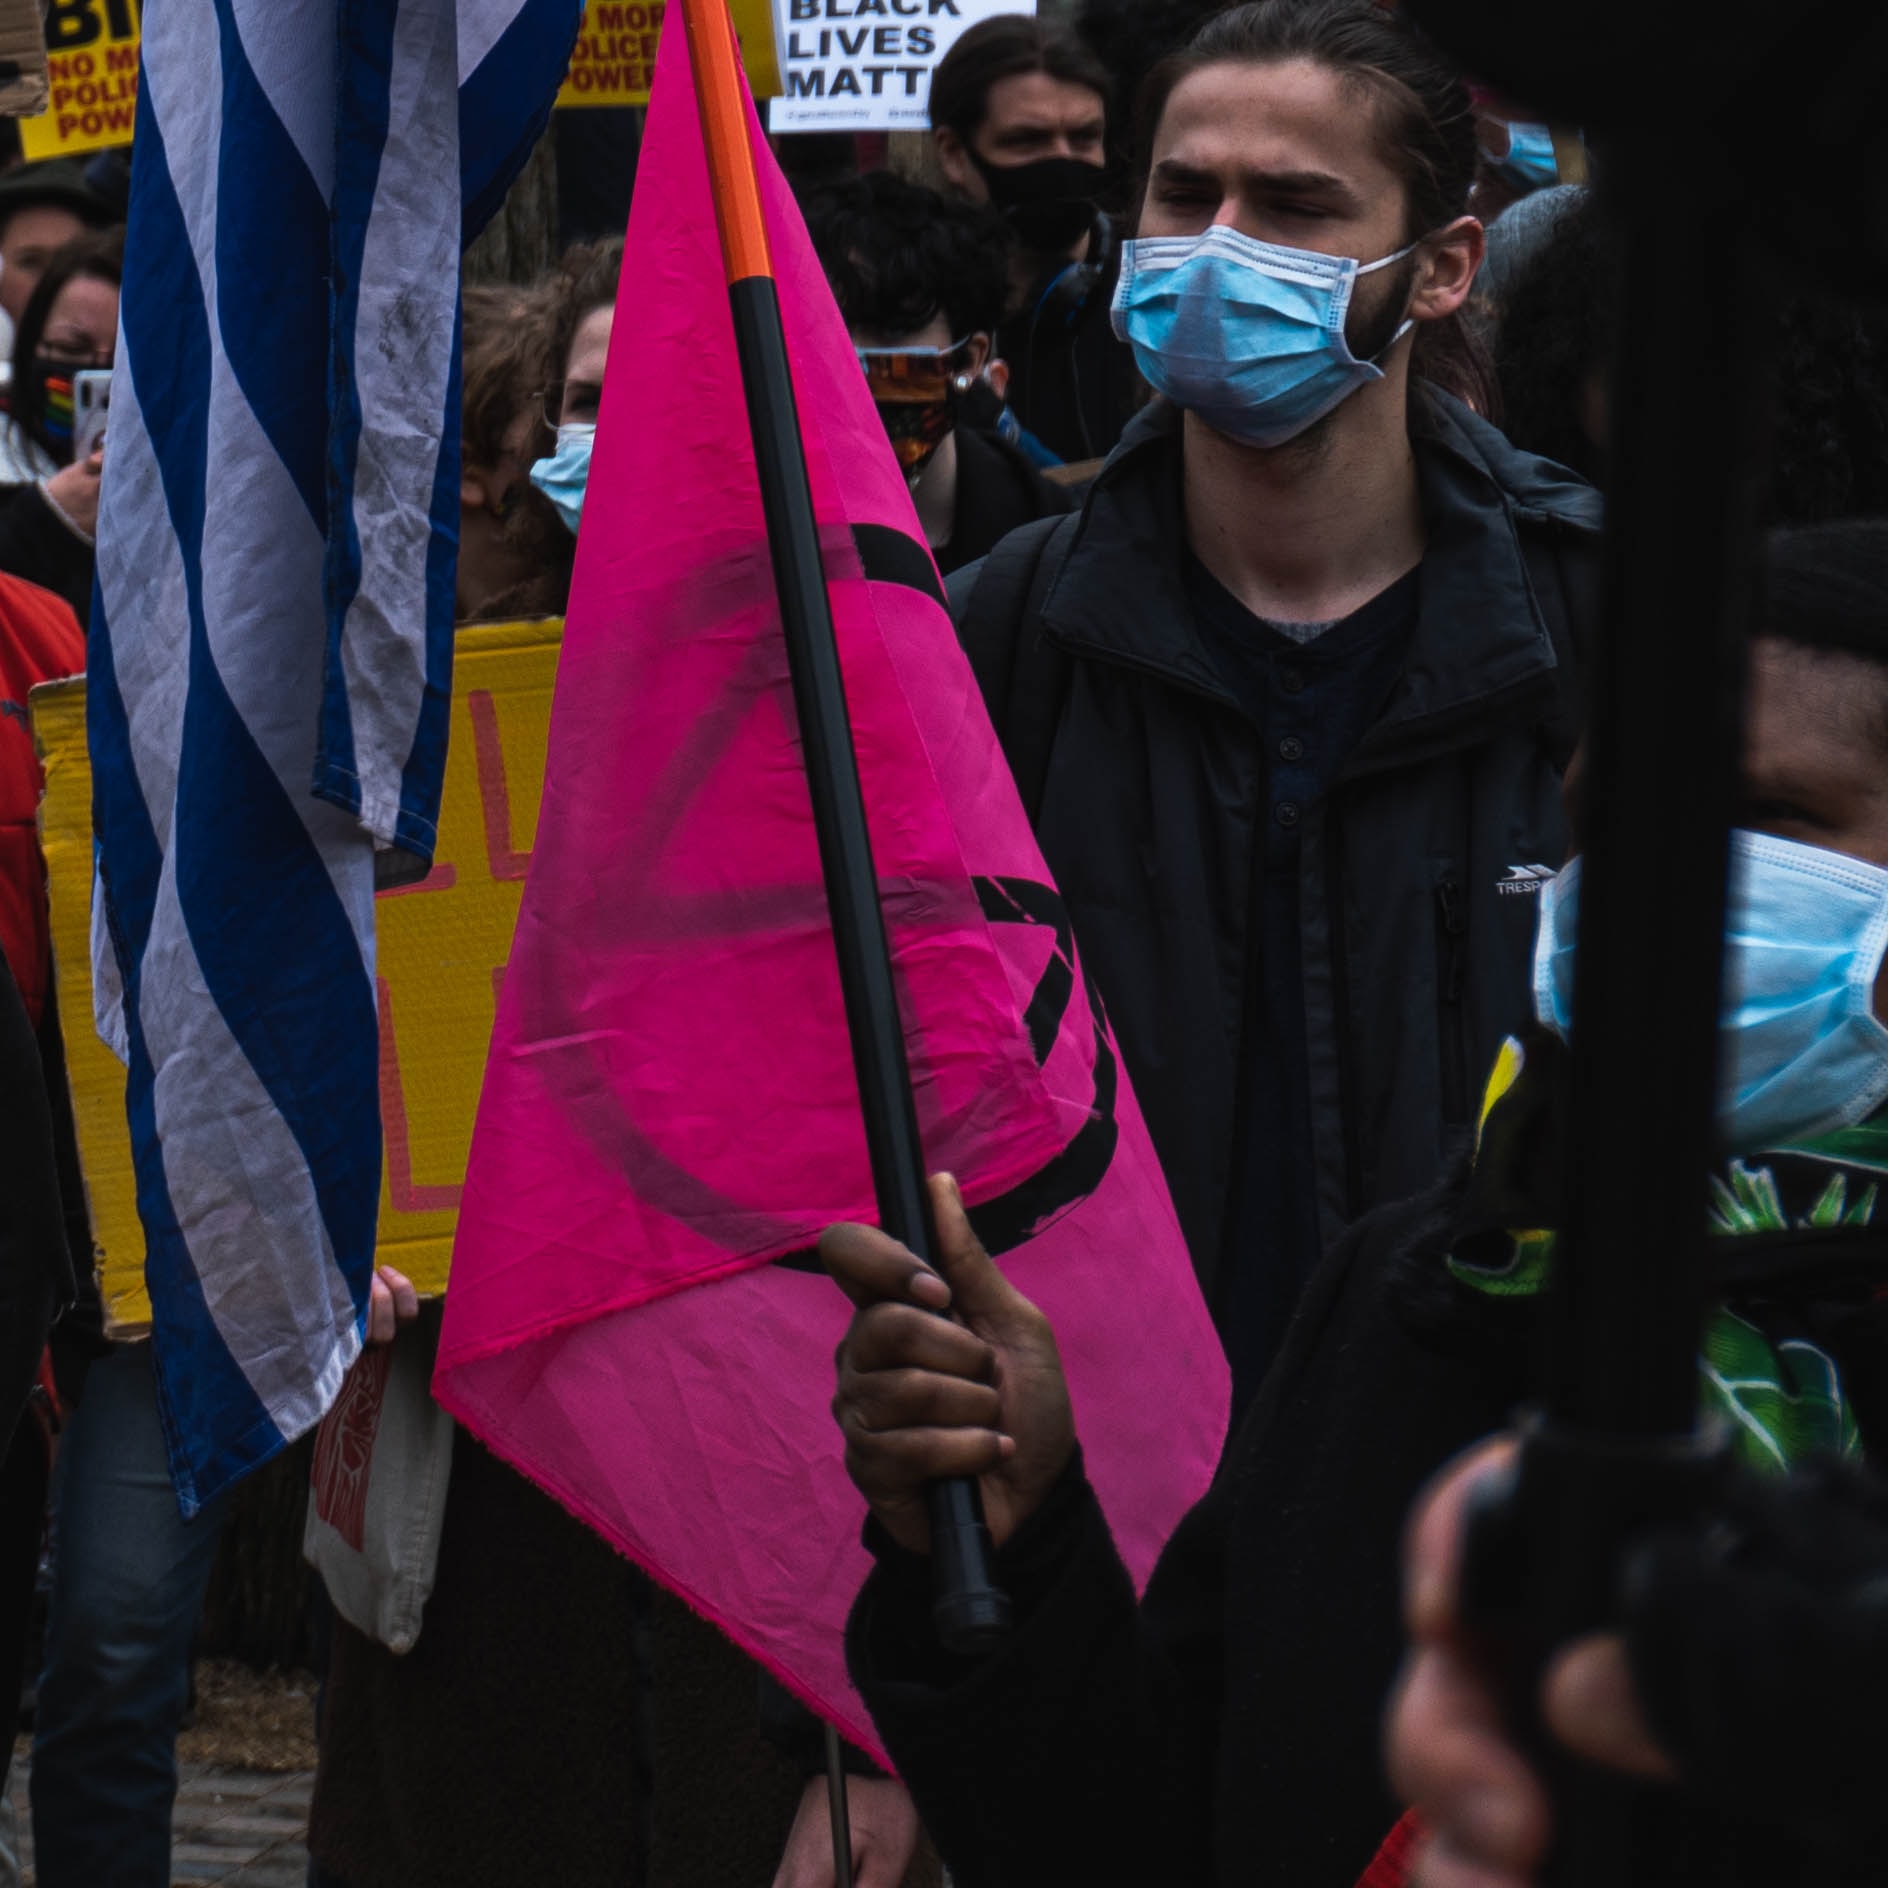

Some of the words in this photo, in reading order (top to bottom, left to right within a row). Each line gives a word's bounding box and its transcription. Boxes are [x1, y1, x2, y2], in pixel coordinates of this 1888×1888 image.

[571, 32, 654, 62] OLICE
[788, 26, 936, 59] LIVES
[48, 53, 95, 81] NO
[786, 65, 936, 98] MATT
[53, 74, 138, 111] POLI
[58, 105, 135, 141] POW
[1495, 880, 1541, 896] TRESP
